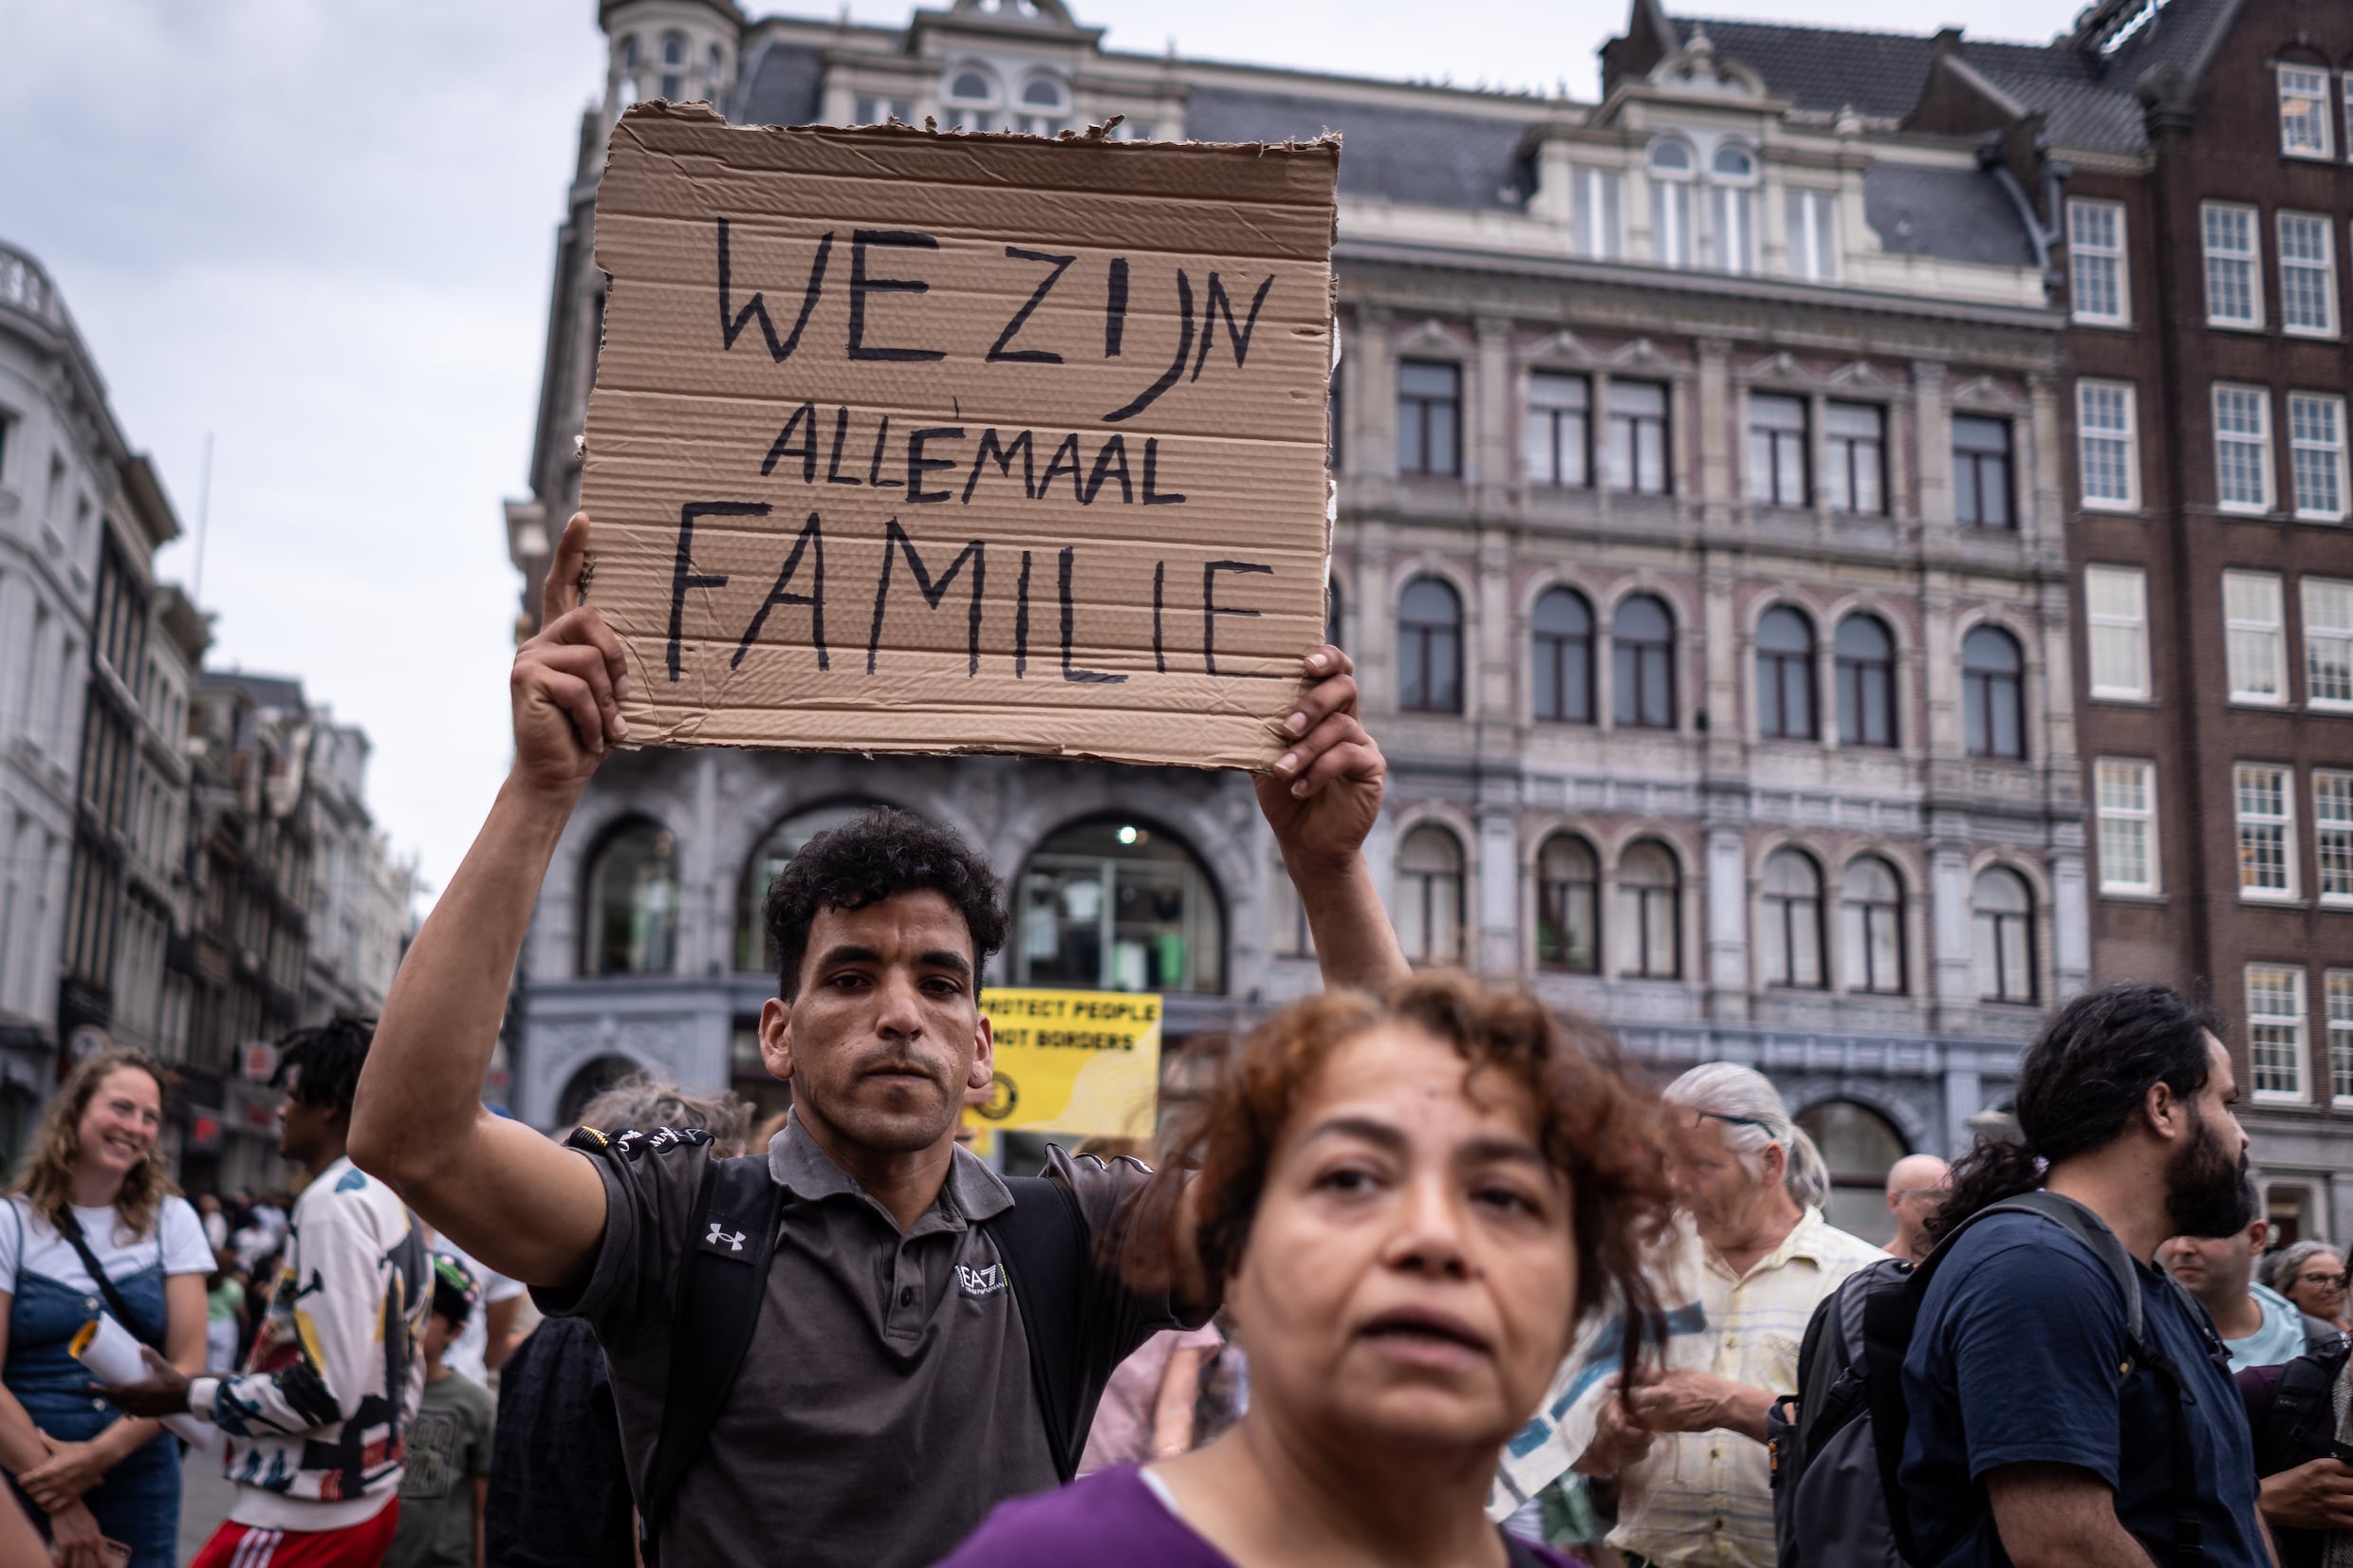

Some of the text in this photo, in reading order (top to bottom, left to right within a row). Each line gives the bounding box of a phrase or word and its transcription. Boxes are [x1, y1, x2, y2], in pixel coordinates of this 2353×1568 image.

[717, 216, 1275, 422] WE ZIJN
[761, 401, 1186, 505] ALLEMAAL
[666, 502, 1283, 683] FAMILIE
[1035, 1029, 1135, 1051] BORDERS
[1073, 1001, 1156, 1022] PEOPLE
[960, 1264, 996, 1288] EA7
